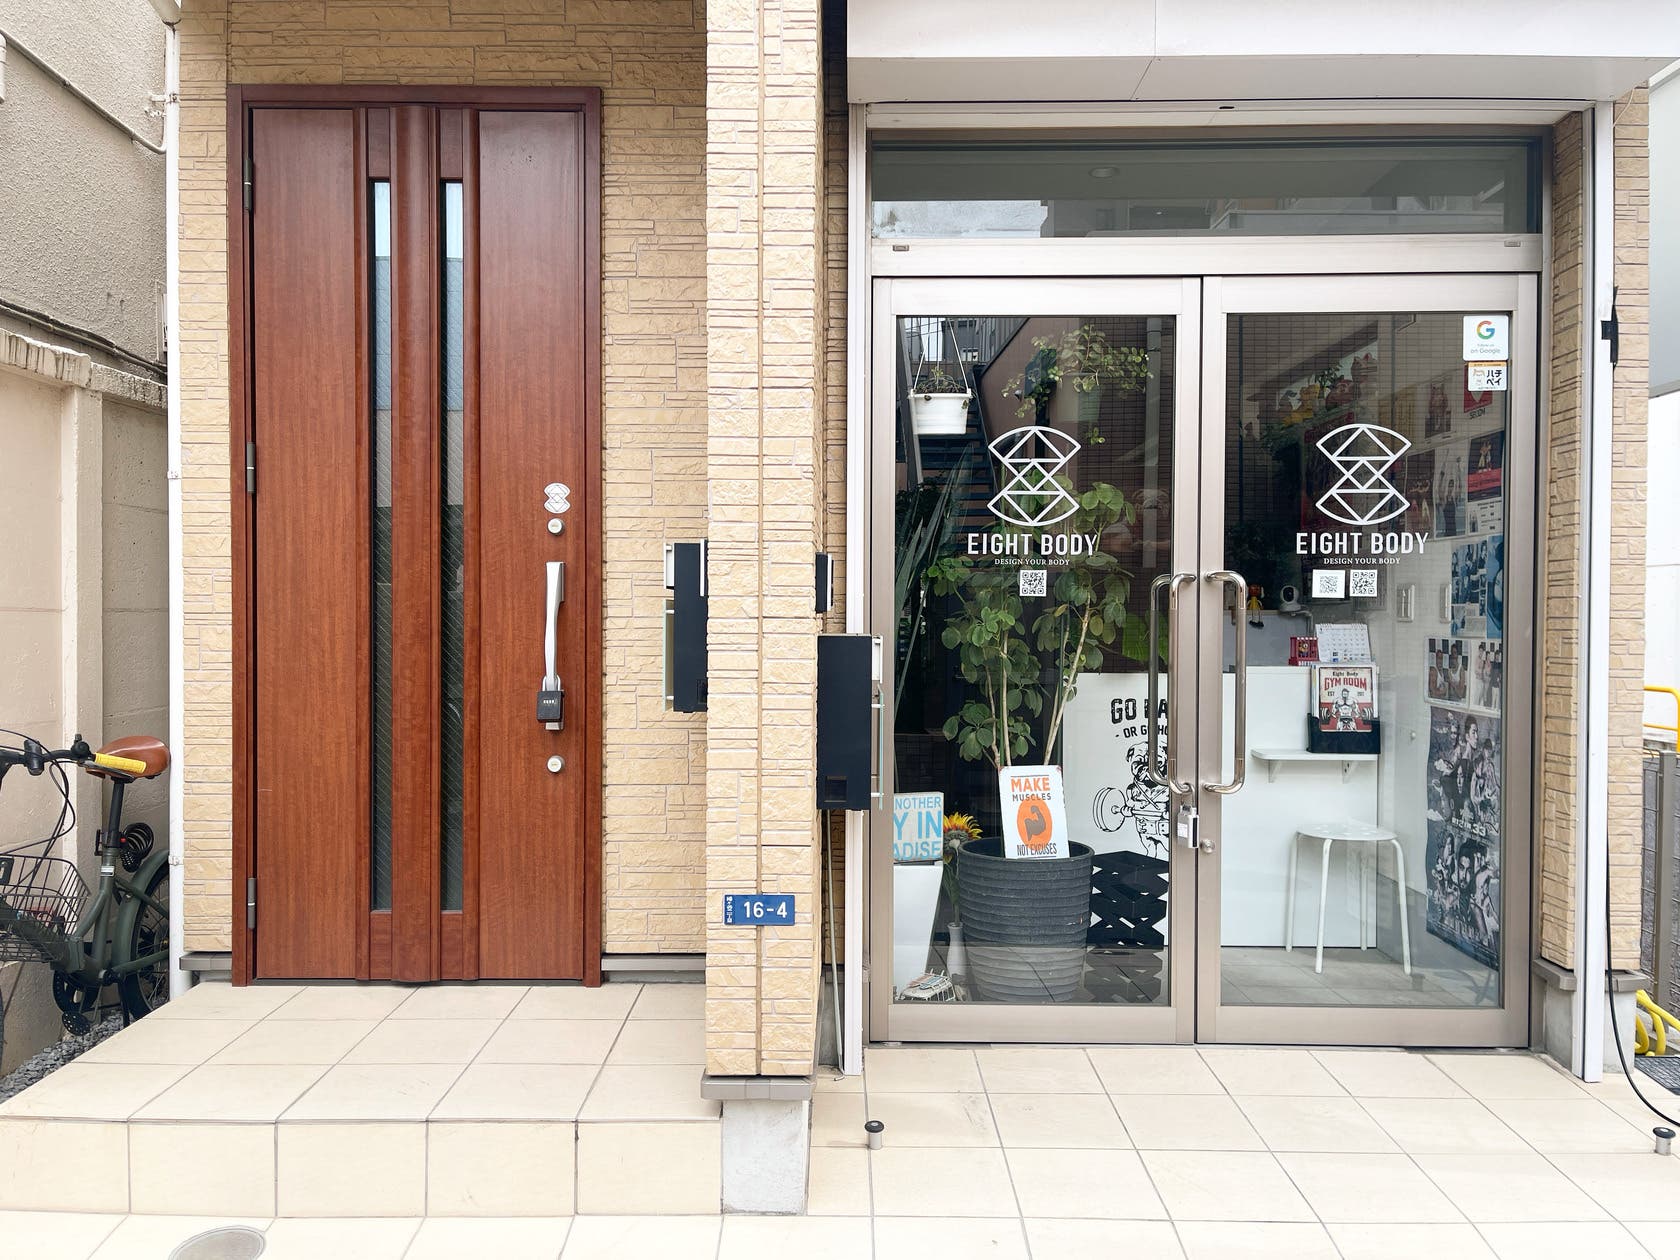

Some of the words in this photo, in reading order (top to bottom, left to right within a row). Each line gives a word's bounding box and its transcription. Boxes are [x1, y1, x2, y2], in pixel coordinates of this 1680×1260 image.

[1476, 320, 1496, 340] G
[1479, 347, 1501, 355] Google
[967, 532, 1033, 555] EIGHT
[1041, 534, 1098, 556] BODY
[1296, 532, 1362, 555] EIGHT
[1370, 532, 1429, 555] BODY
[1025, 558, 1047, 566] YOUR
[1323, 557, 1353, 565] DESIGN
[1355, 557, 1377, 565] YOUR
[1378, 557, 1401, 565] BODY
[1324, 677, 1342, 691] GYM
[1343, 677, 1367, 691] ROOM
[1111, 698, 1136, 724] GO
[1123, 726, 1138, 738] OR
[1010, 777, 1051, 792] MAKE
[895, 796, 942, 810] NOTHER
[1012, 793, 1052, 802] MUSCLES
[917, 810, 942, 839] IN
[1016, 844, 1029, 856] NOT
[1030, 843, 1058, 855] EXCUSES
[743, 901, 788, 919] 16-4
